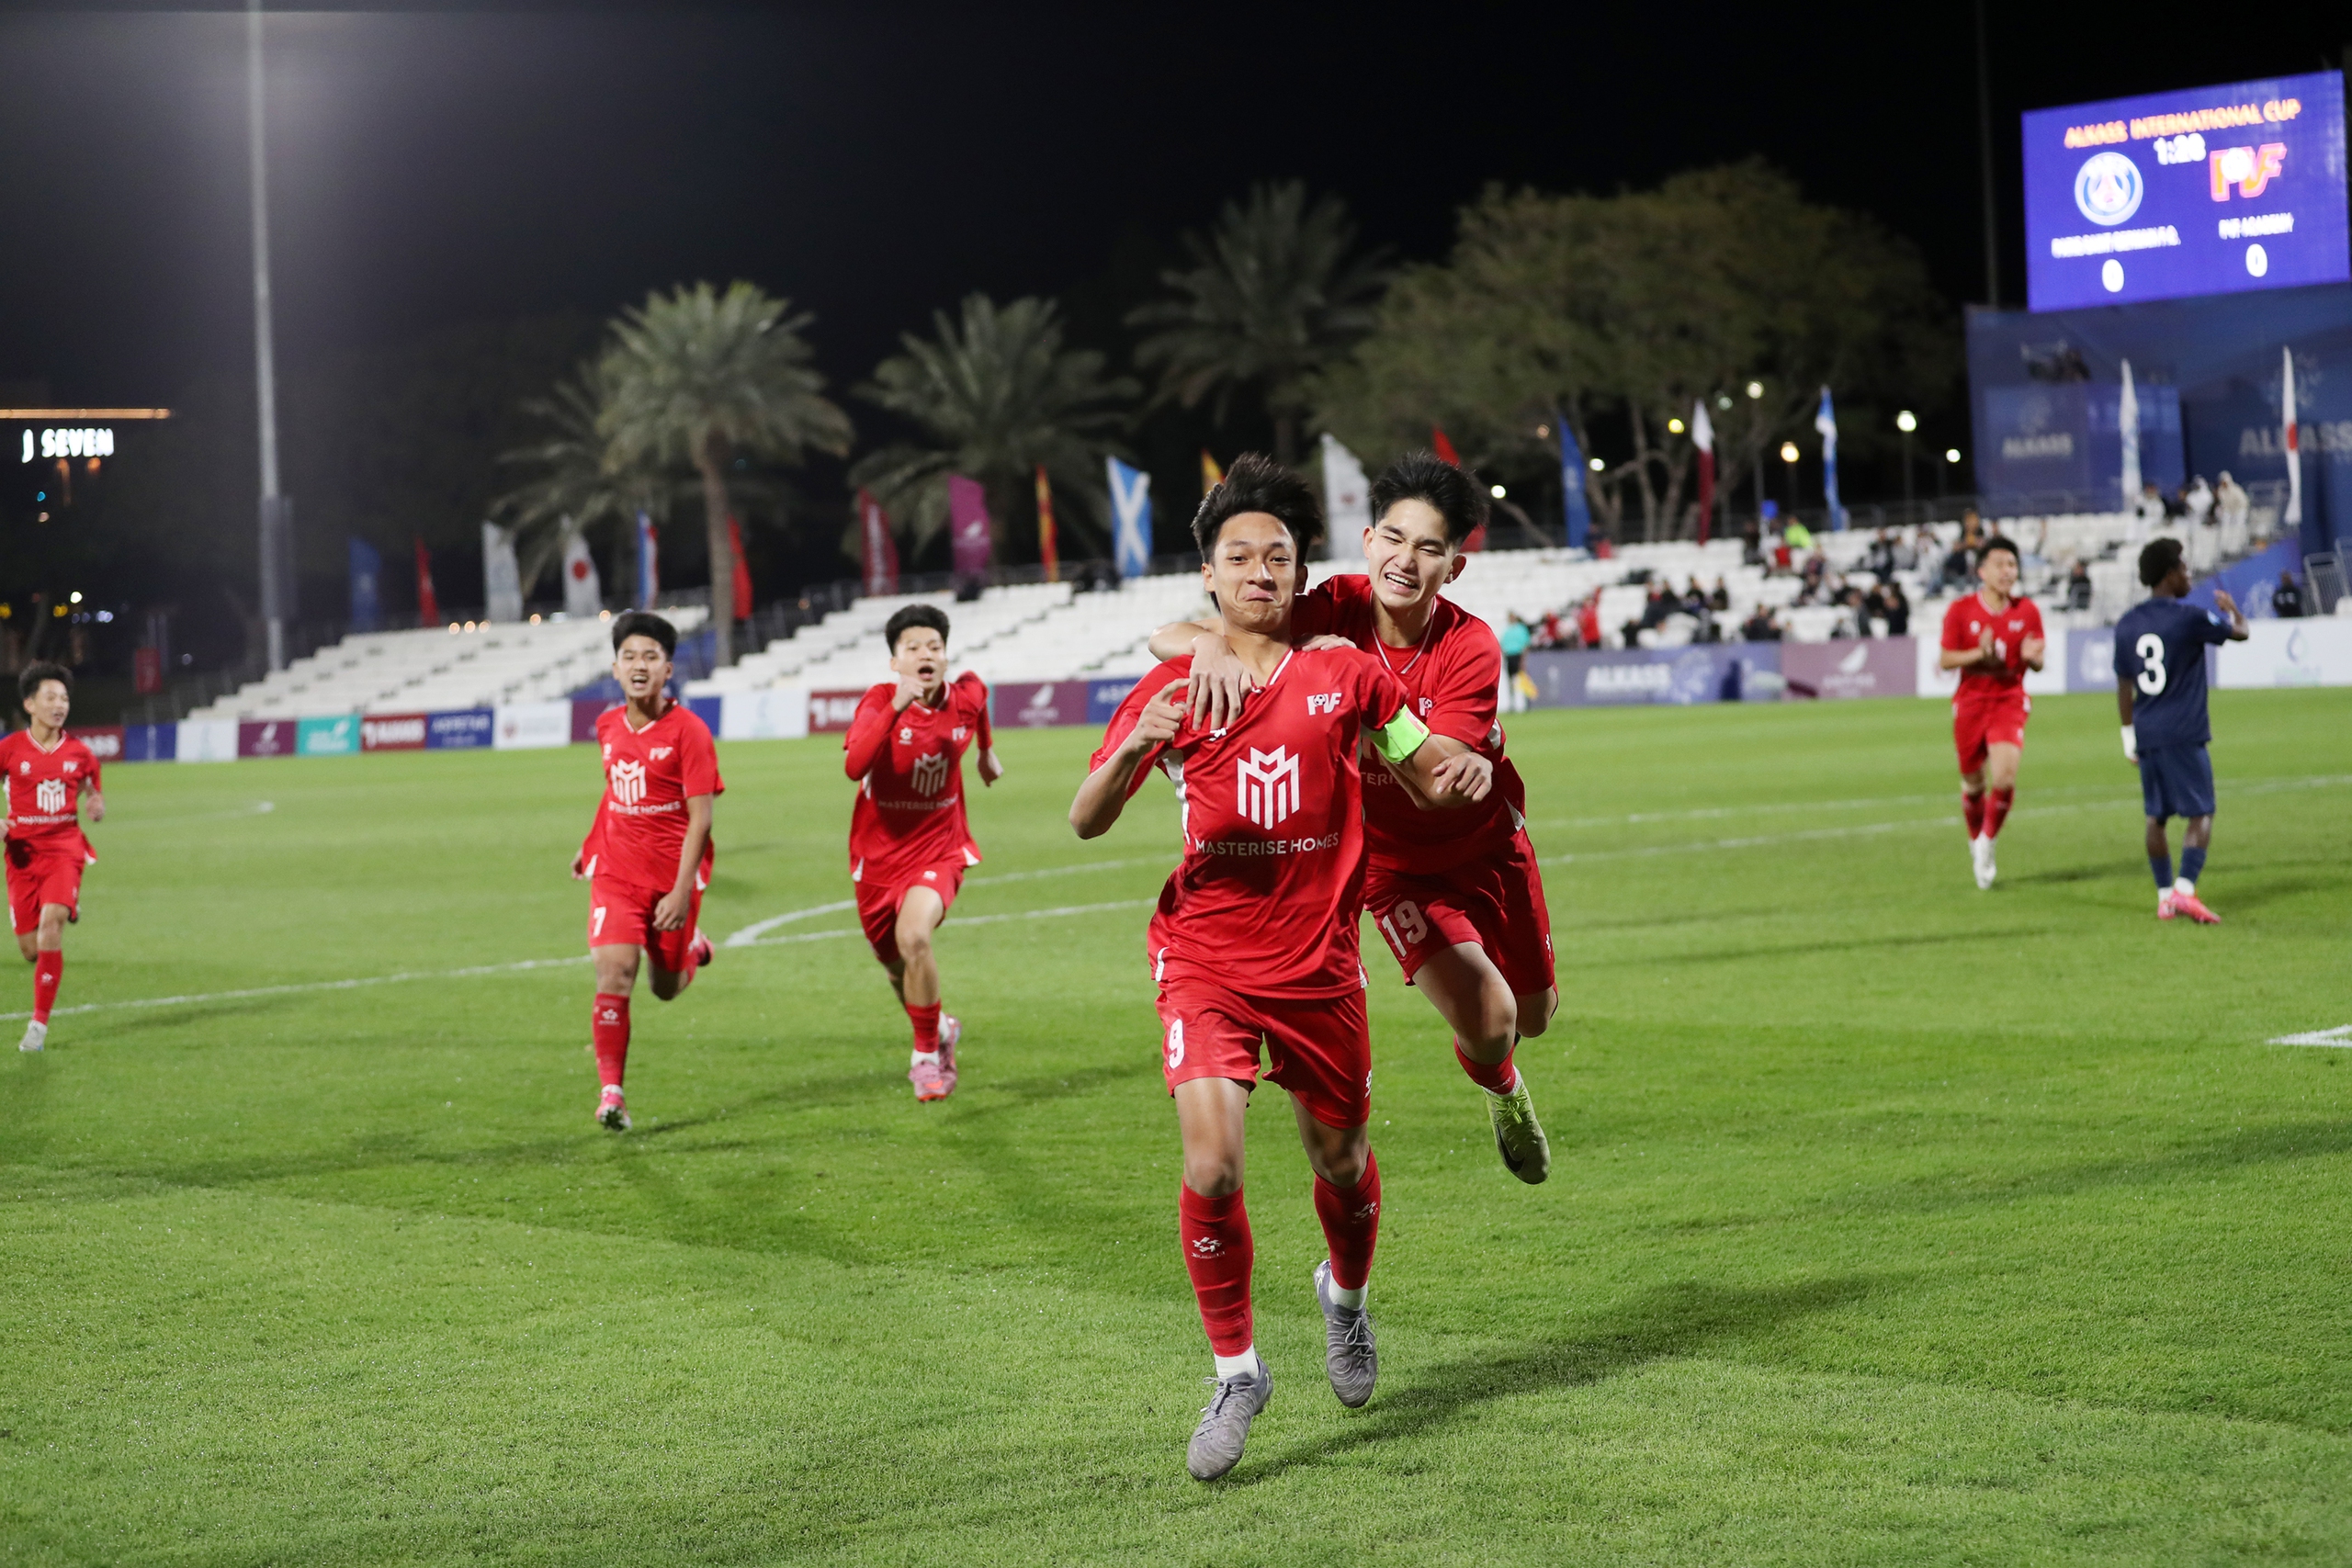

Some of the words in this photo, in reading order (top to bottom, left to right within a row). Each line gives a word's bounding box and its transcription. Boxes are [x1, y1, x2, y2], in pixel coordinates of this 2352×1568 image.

[2064, 119, 2129, 149] ALKASS
[2130, 103, 2265, 140] INTERNATIONAL
[2263, 98, 2301, 122] CUP
[2101, 258, 2125, 292] 0
[2245, 243, 2268, 277] 0
[21, 428, 34, 464] J
[41, 428, 114, 457] SEVEN
[2136, 633, 2166, 696] 3
[1306, 692, 1342, 716] PVF
[640, 800, 681, 816] HOMES
[1194, 837, 1287, 856] MASTERISE
[1290, 832, 1339, 852] HOMES
[593, 906, 606, 937] 7
[1381, 900, 1429, 957] 19
[1169, 1018, 1185, 1070] 9
